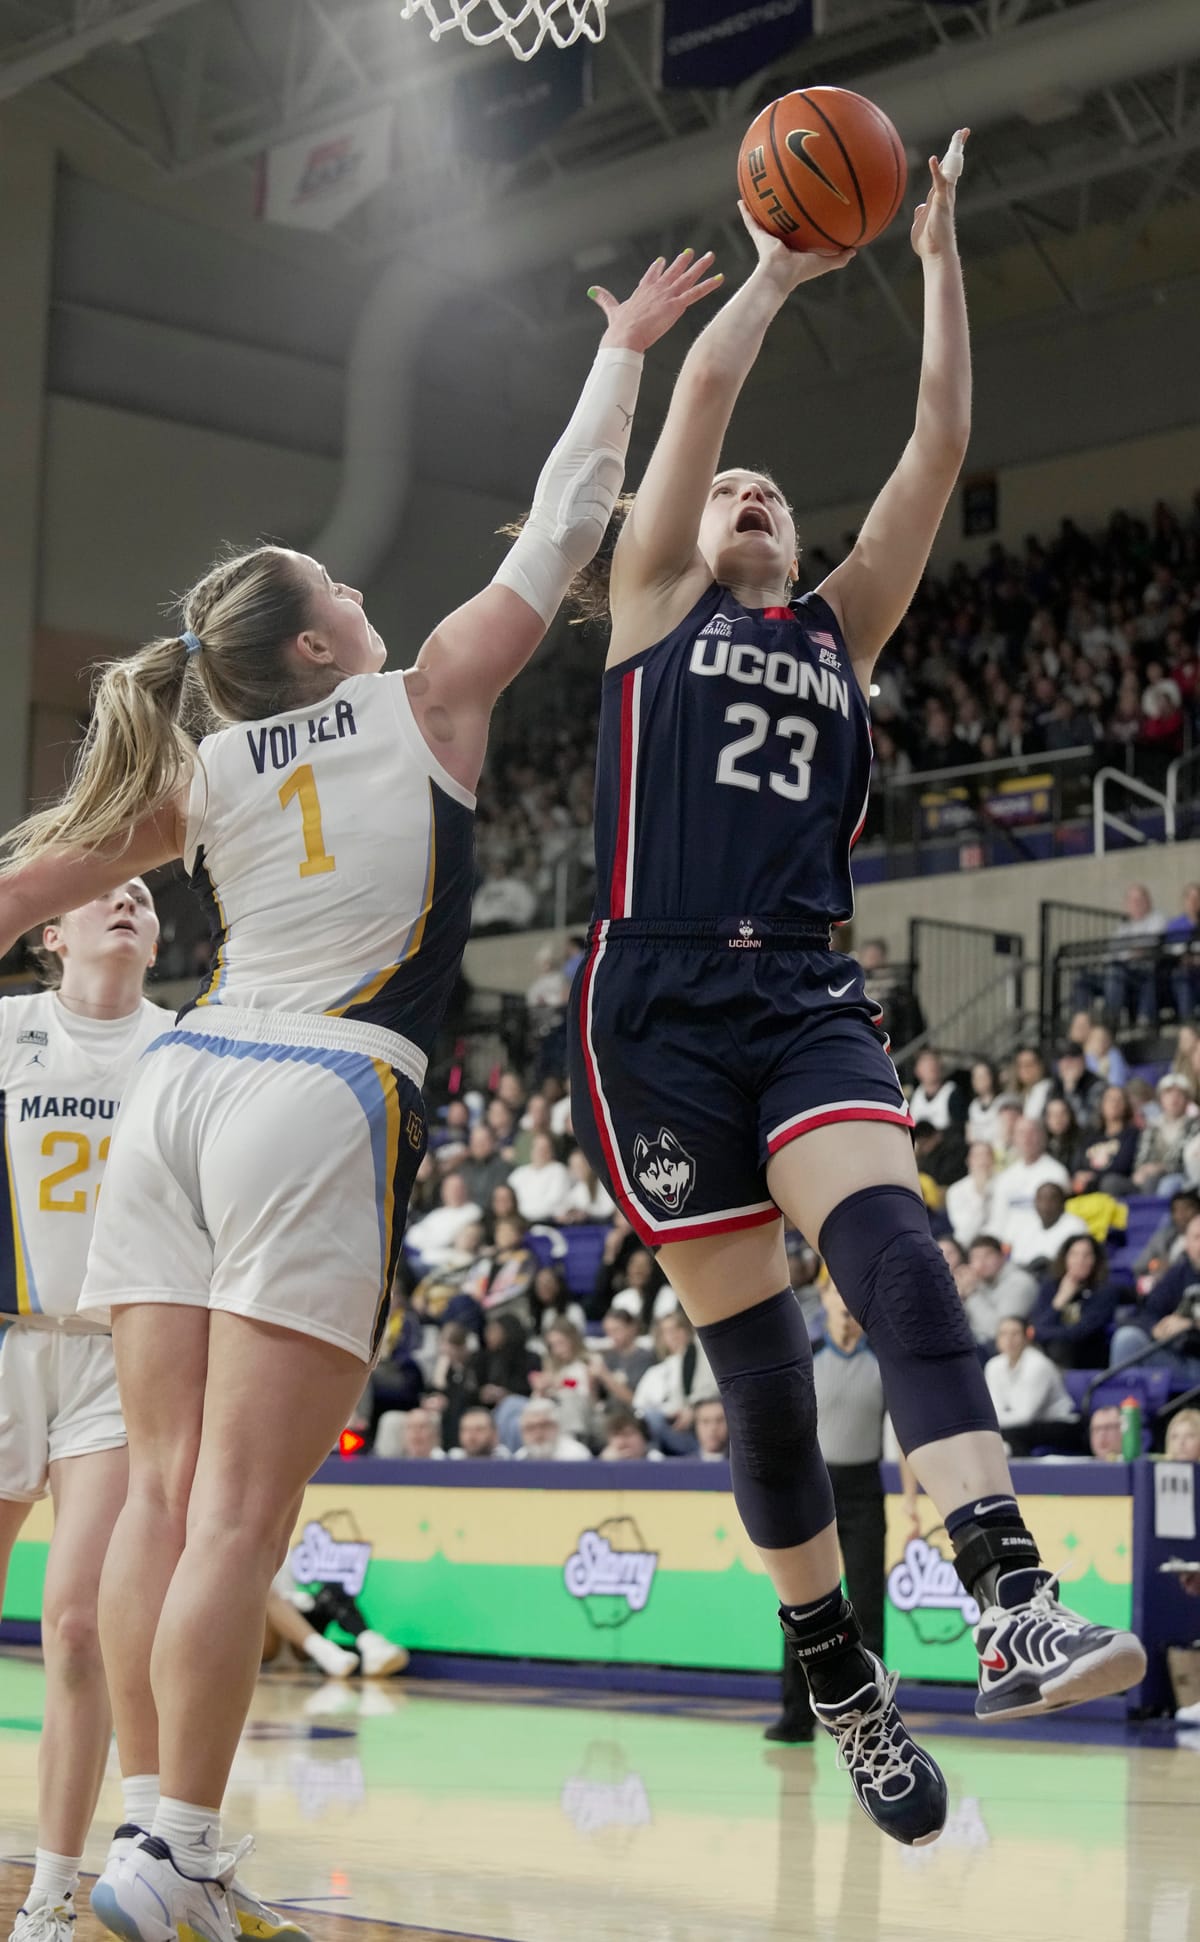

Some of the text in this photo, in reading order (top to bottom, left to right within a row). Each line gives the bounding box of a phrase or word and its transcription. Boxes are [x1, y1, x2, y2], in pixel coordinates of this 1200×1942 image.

[748, 144, 800, 235] ELITE
[689, 639, 849, 721] UCONN
[715, 702, 819, 801] 23
[278, 764, 336, 878] 1
[728, 939, 762, 949] UCONN
[20, 1095, 121, 1122] MARQU
[1001, 1537, 1035, 1547] ZAMS
